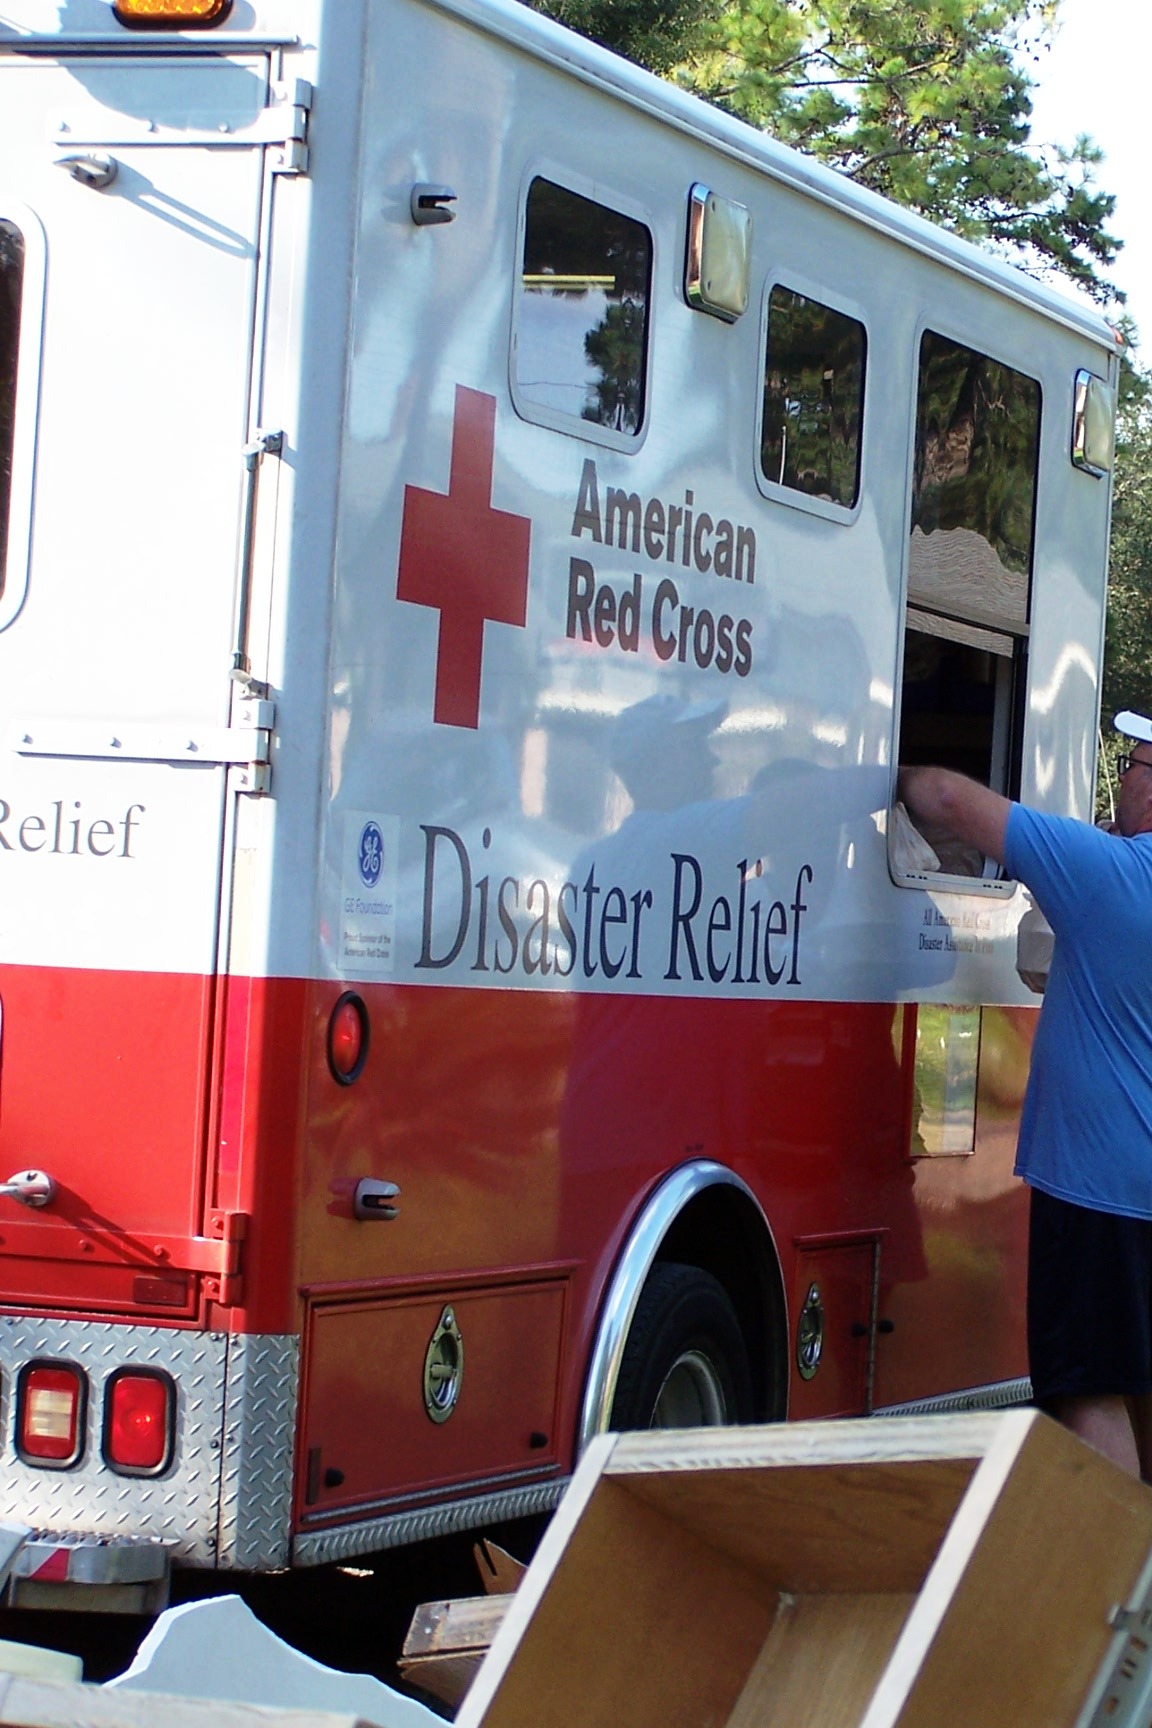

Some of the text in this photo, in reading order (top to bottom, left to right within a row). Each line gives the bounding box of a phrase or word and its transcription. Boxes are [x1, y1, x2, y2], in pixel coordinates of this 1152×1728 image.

[570, 458, 757, 584] American
[566, 557, 753, 678] Red Cross
[414, 824, 813, 985] Disaster Relief
